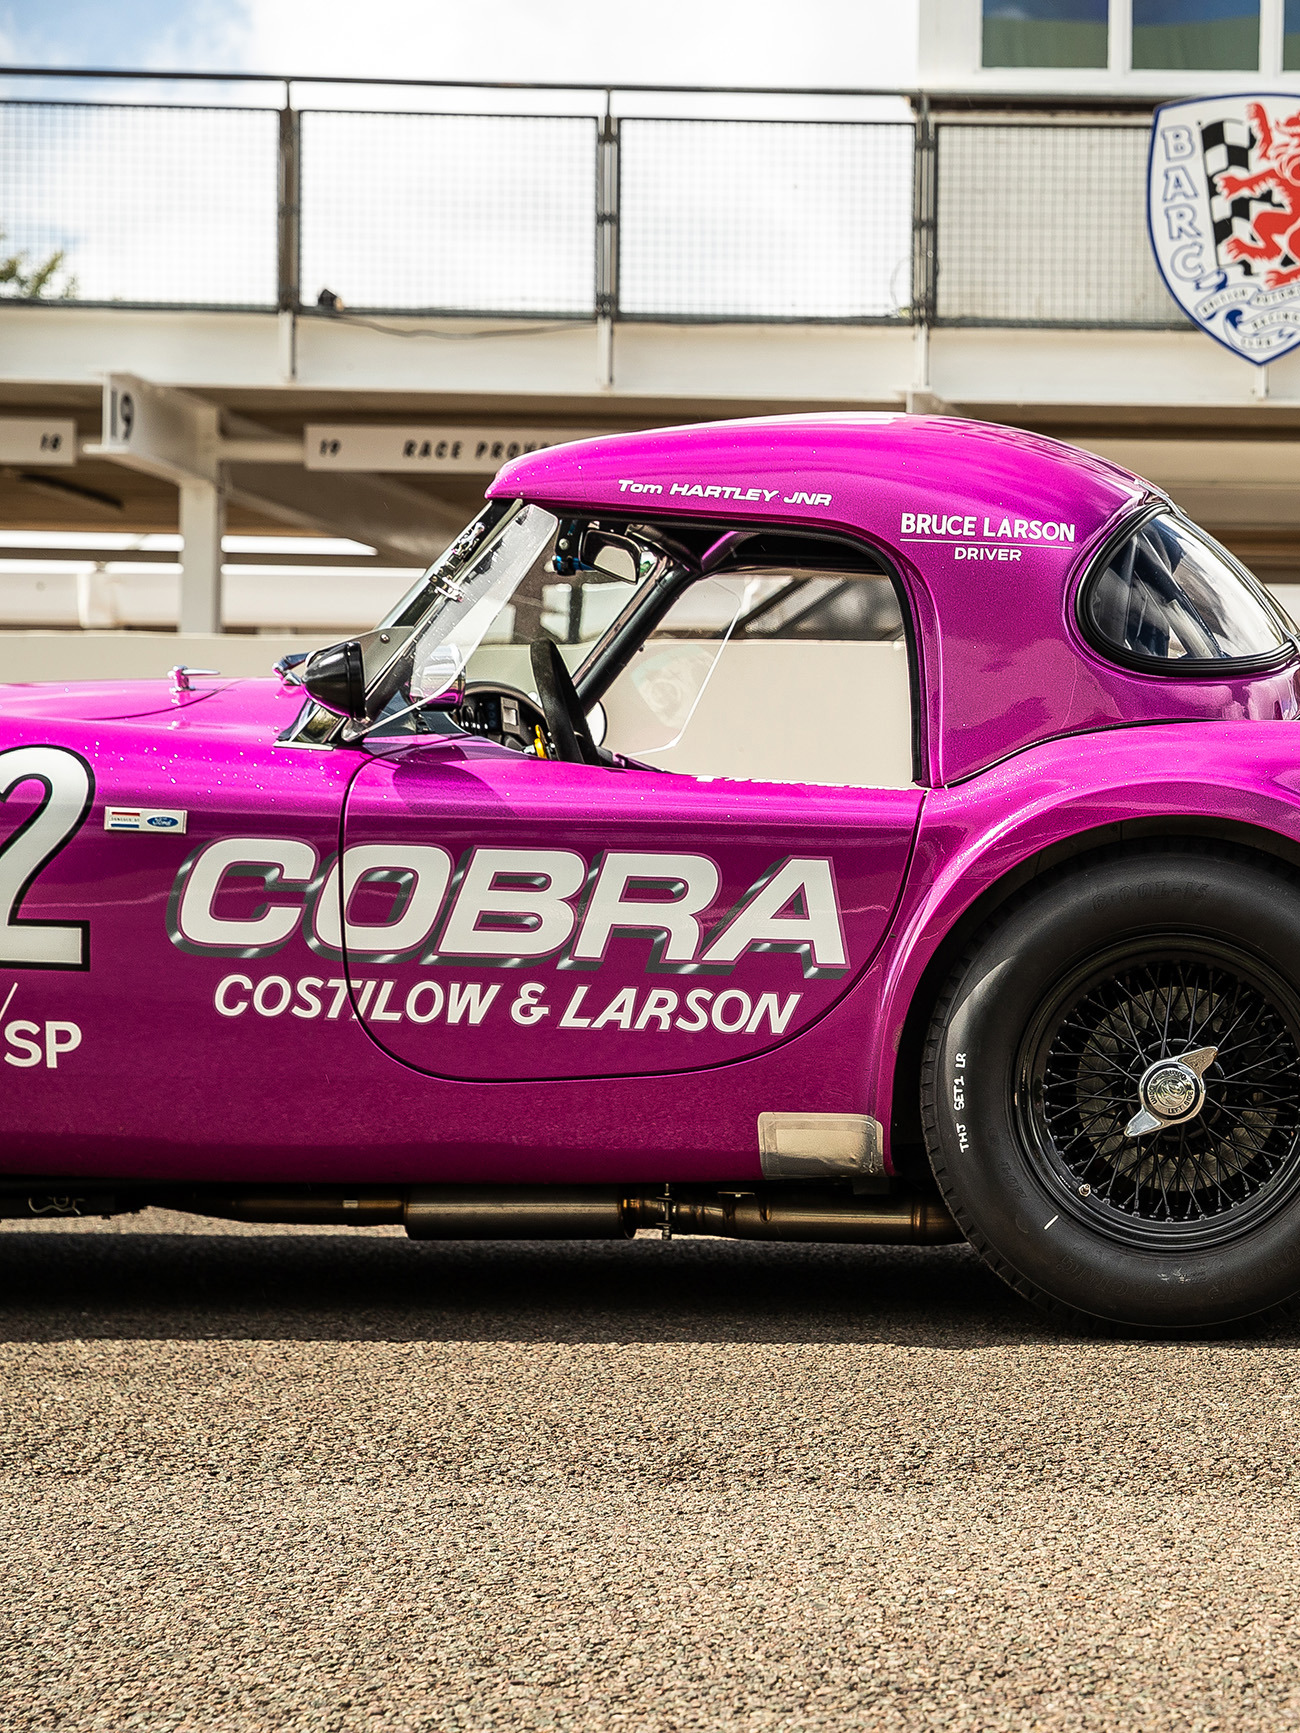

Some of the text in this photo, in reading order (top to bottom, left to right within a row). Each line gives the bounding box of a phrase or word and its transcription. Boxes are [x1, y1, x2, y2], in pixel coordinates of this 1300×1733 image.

[1161, 125, 1204, 283] BARC
[110, 387, 134, 441] 19
[402, 440, 462, 460] RACE
[618, 480, 832, 507] Tom HARTLEY JNR
[900, 512, 1076, 543] BRUCE LARSON
[954, 547, 1022, 562] DRIVER
[150, 815, 175, 828] Ford
[168, 837, 852, 978] COBRA
[213, 973, 803, 1036] COSTILOW & LARSON
[955, 1052, 967, 1069] LR
[956, 1122, 970, 1154] THJ
